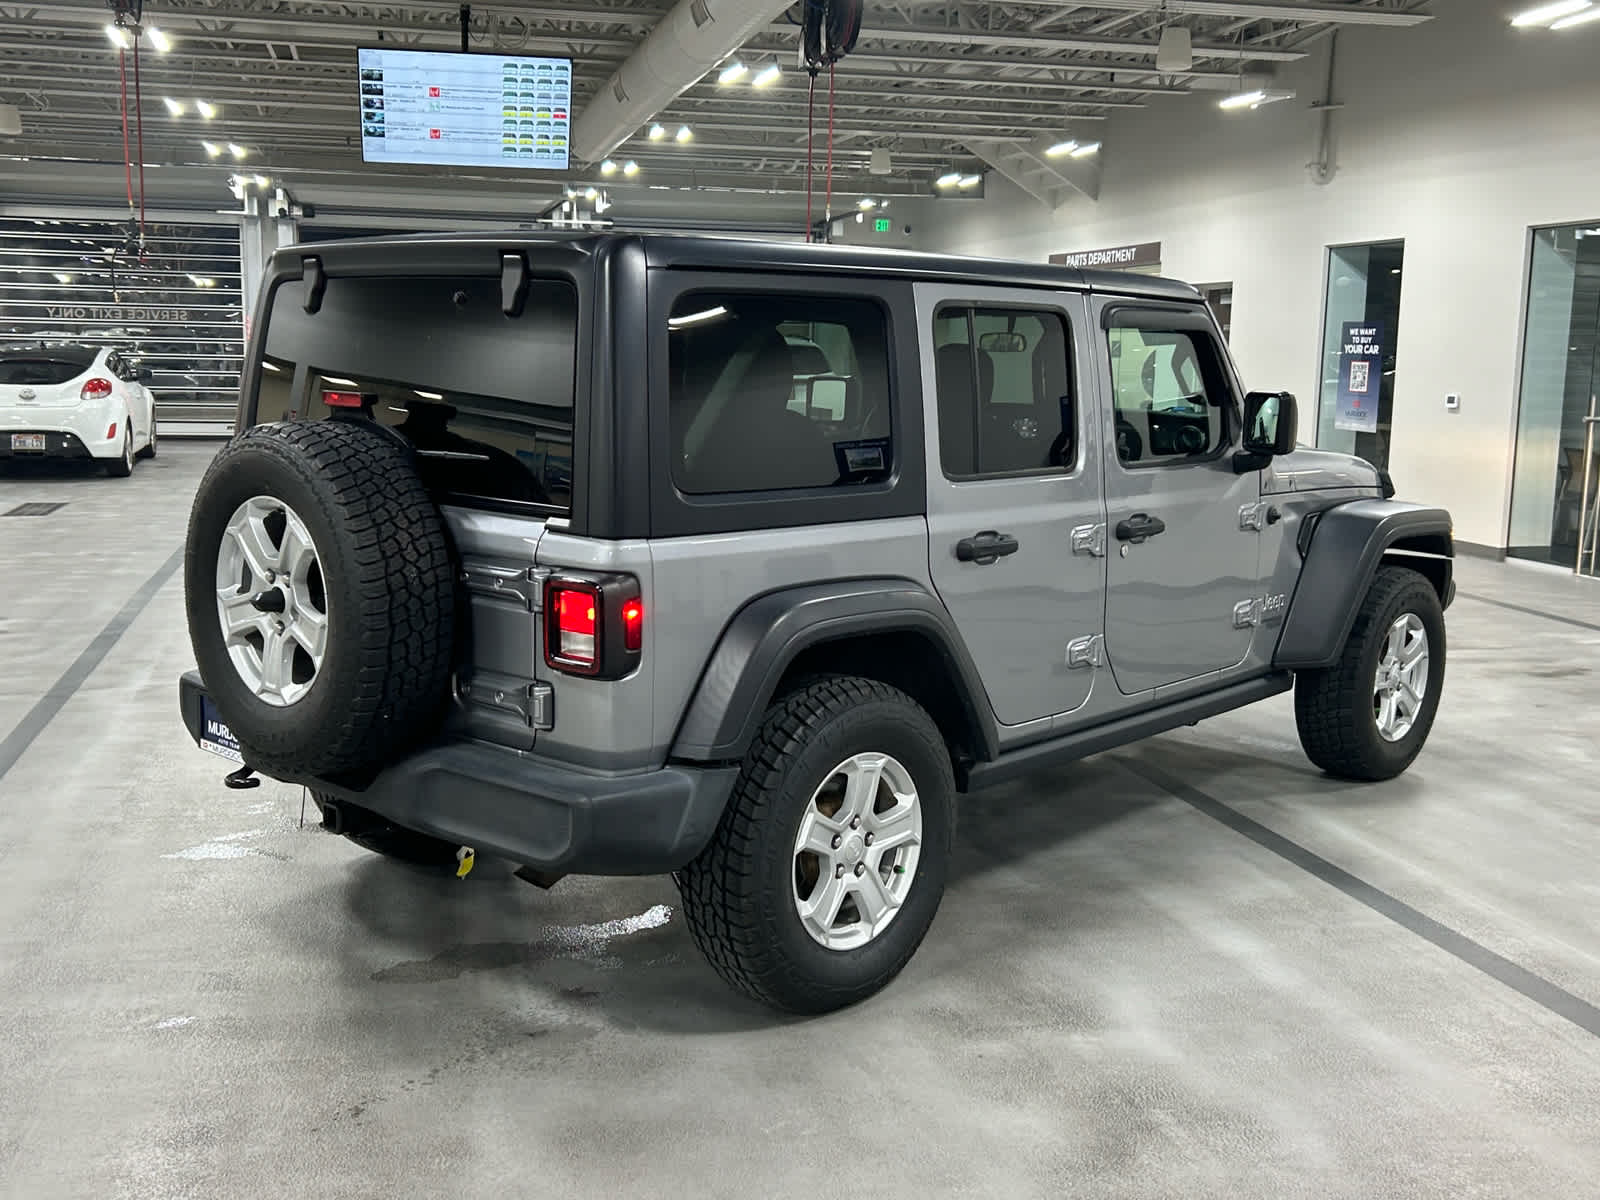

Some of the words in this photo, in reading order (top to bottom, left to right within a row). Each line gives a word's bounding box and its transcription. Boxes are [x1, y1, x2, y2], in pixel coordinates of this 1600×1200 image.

[875, 219, 889, 232] EXIT
[1066, 254, 1088, 267] PARTS
[1088, 248, 1136, 265] DEPARTMENT
[1350, 328, 1359, 336] WE
[1360, 328, 1376, 336] WANT
[1352, 336, 1360, 344] TO
[1360, 336, 1372, 344] BUY
[1344, 344, 1363, 354] YOUR
[1364, 344, 1379, 354] CAR
[1263, 593, 1285, 612] Jeep
